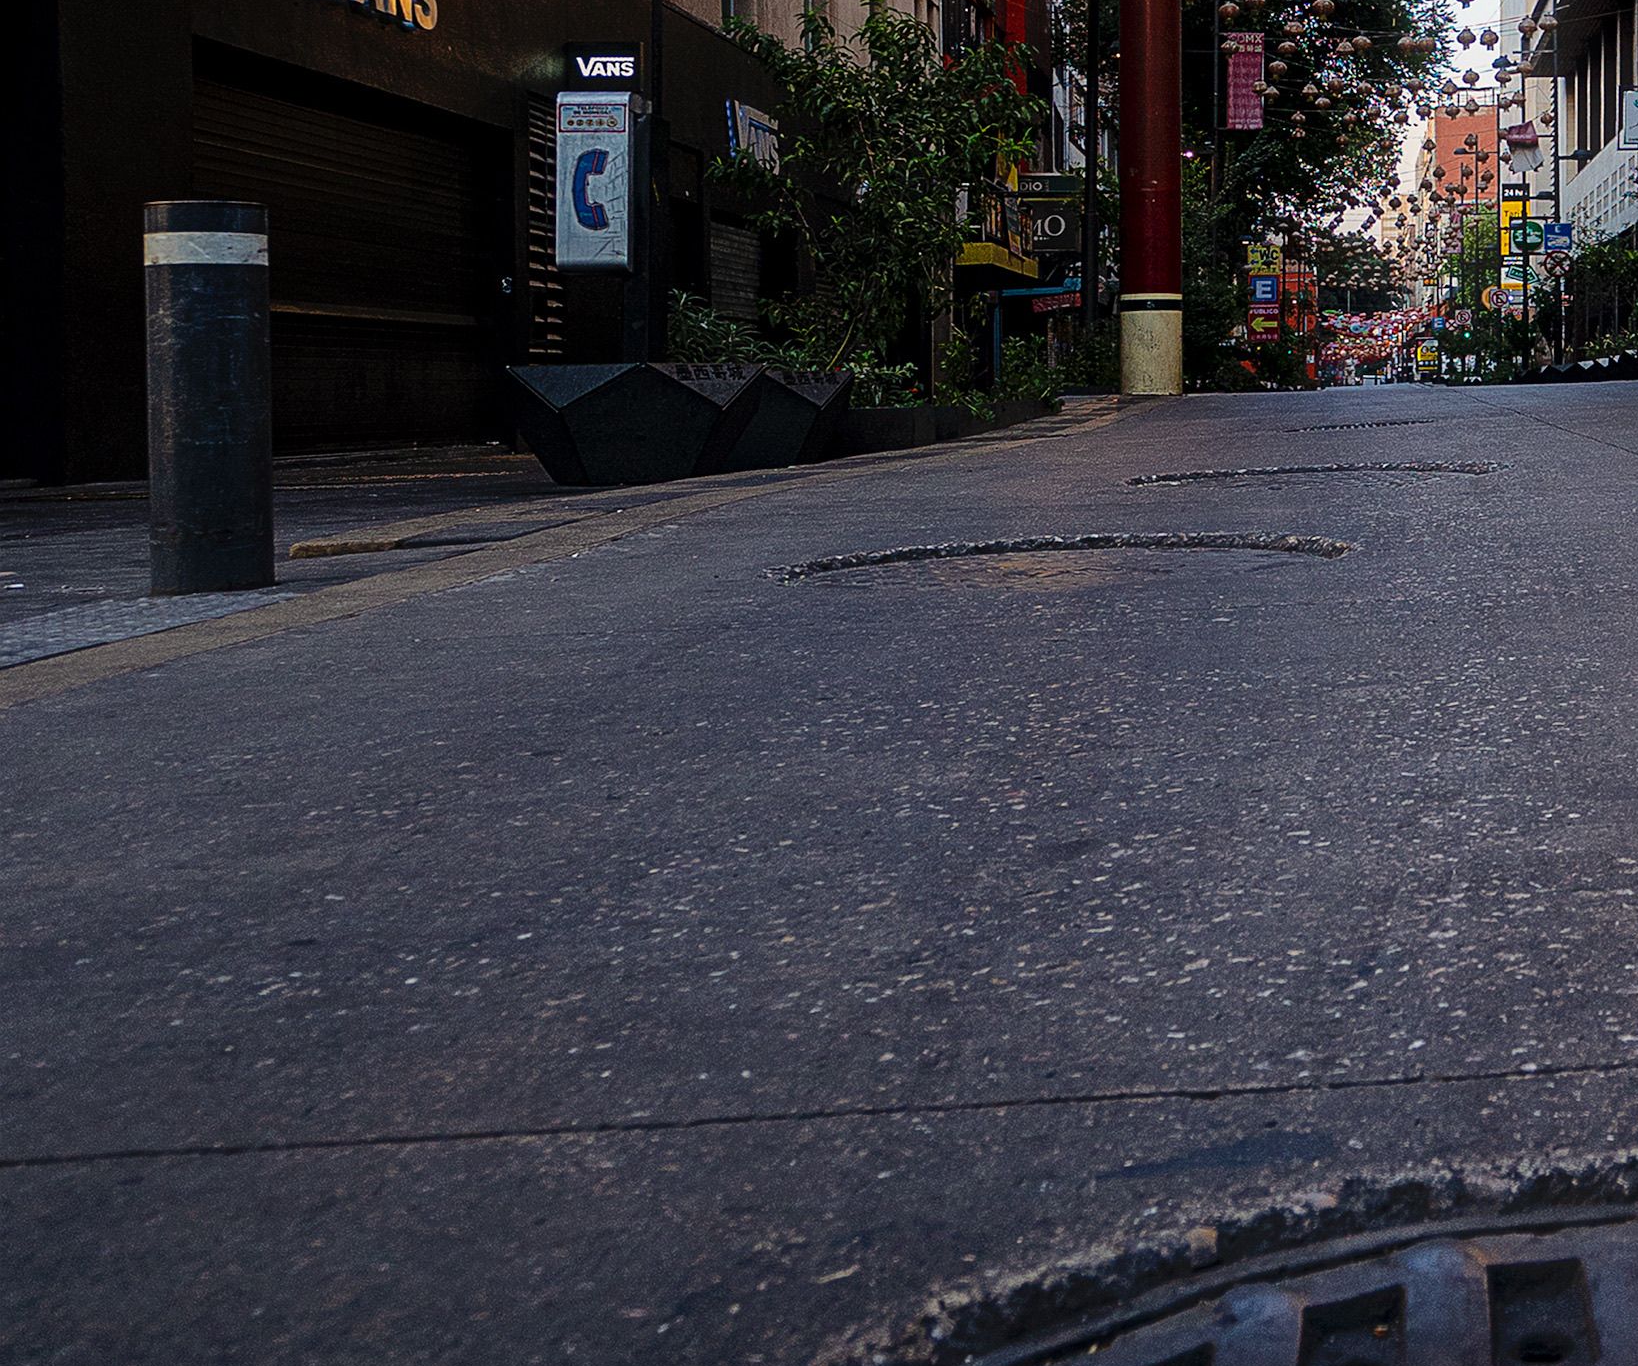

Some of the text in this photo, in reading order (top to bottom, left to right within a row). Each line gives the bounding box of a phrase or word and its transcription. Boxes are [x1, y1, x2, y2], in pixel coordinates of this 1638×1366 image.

[576, 56, 635, 77] VANS
[1503, 189, 1514, 197] 24
[1260, 249, 1279, 260] WC
[1255, 280, 1273, 299] E
